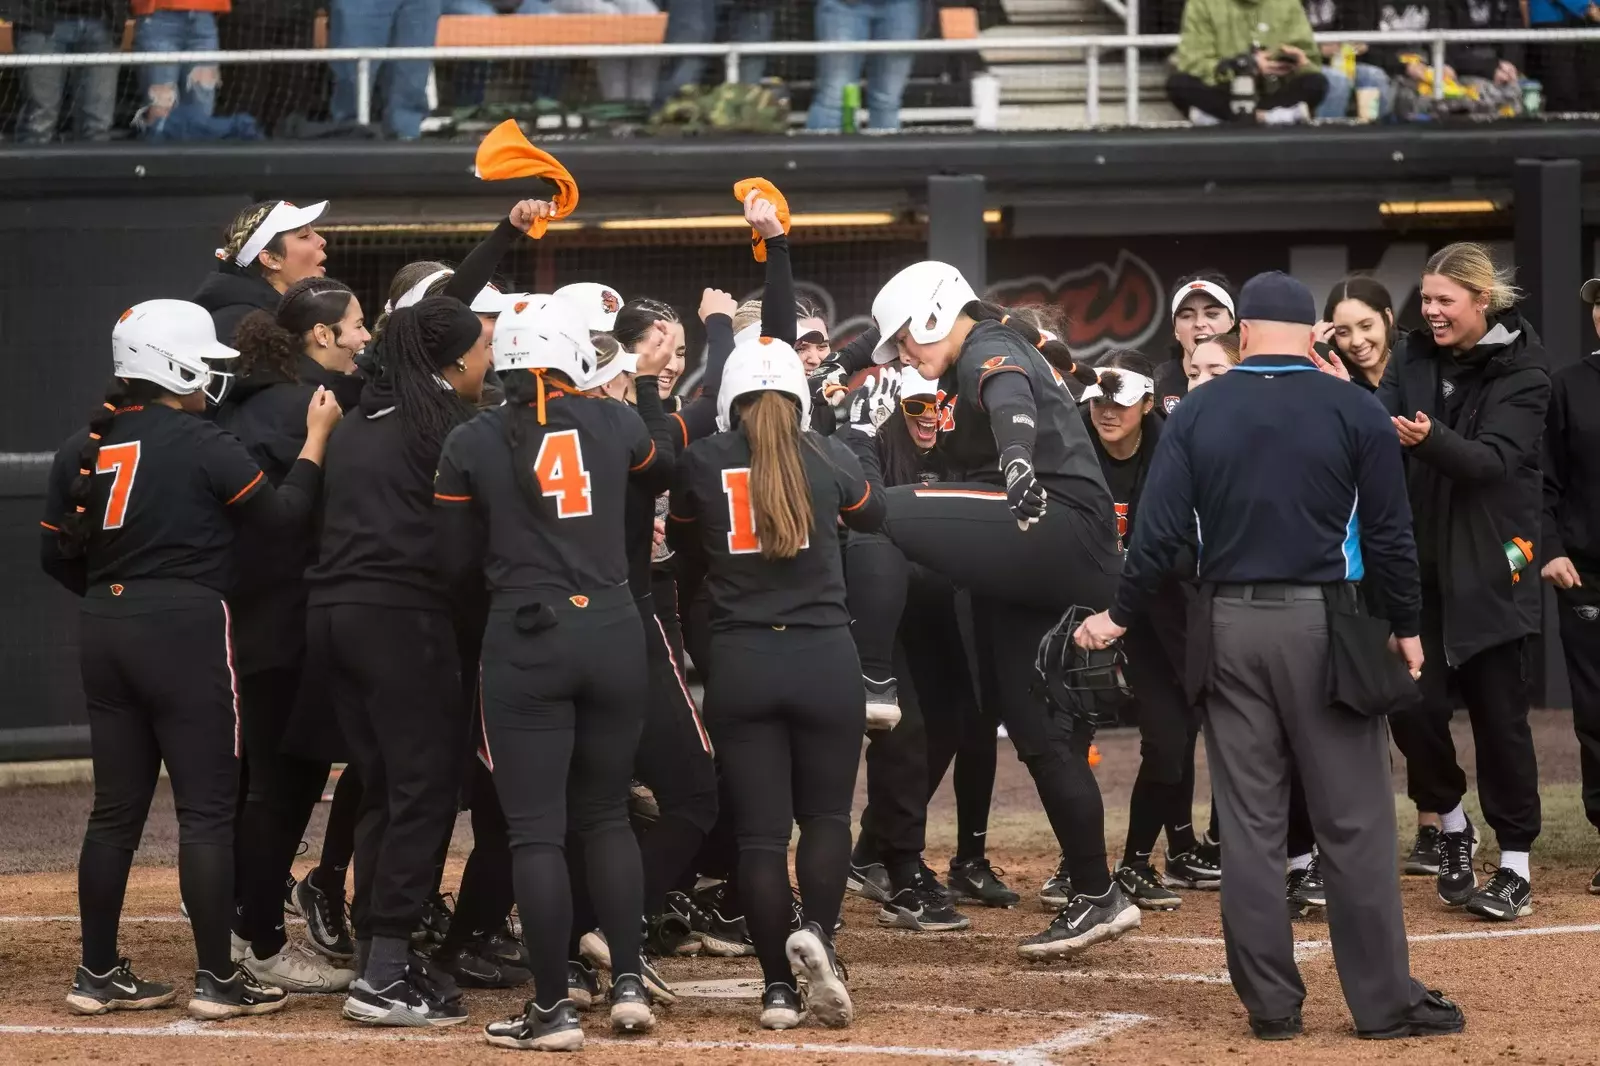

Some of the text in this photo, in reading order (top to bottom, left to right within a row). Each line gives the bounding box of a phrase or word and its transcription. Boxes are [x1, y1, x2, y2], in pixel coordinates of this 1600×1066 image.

[96, 440, 141, 530] 7
[533, 429, 593, 519] 4
[721, 467, 809, 554] 1
